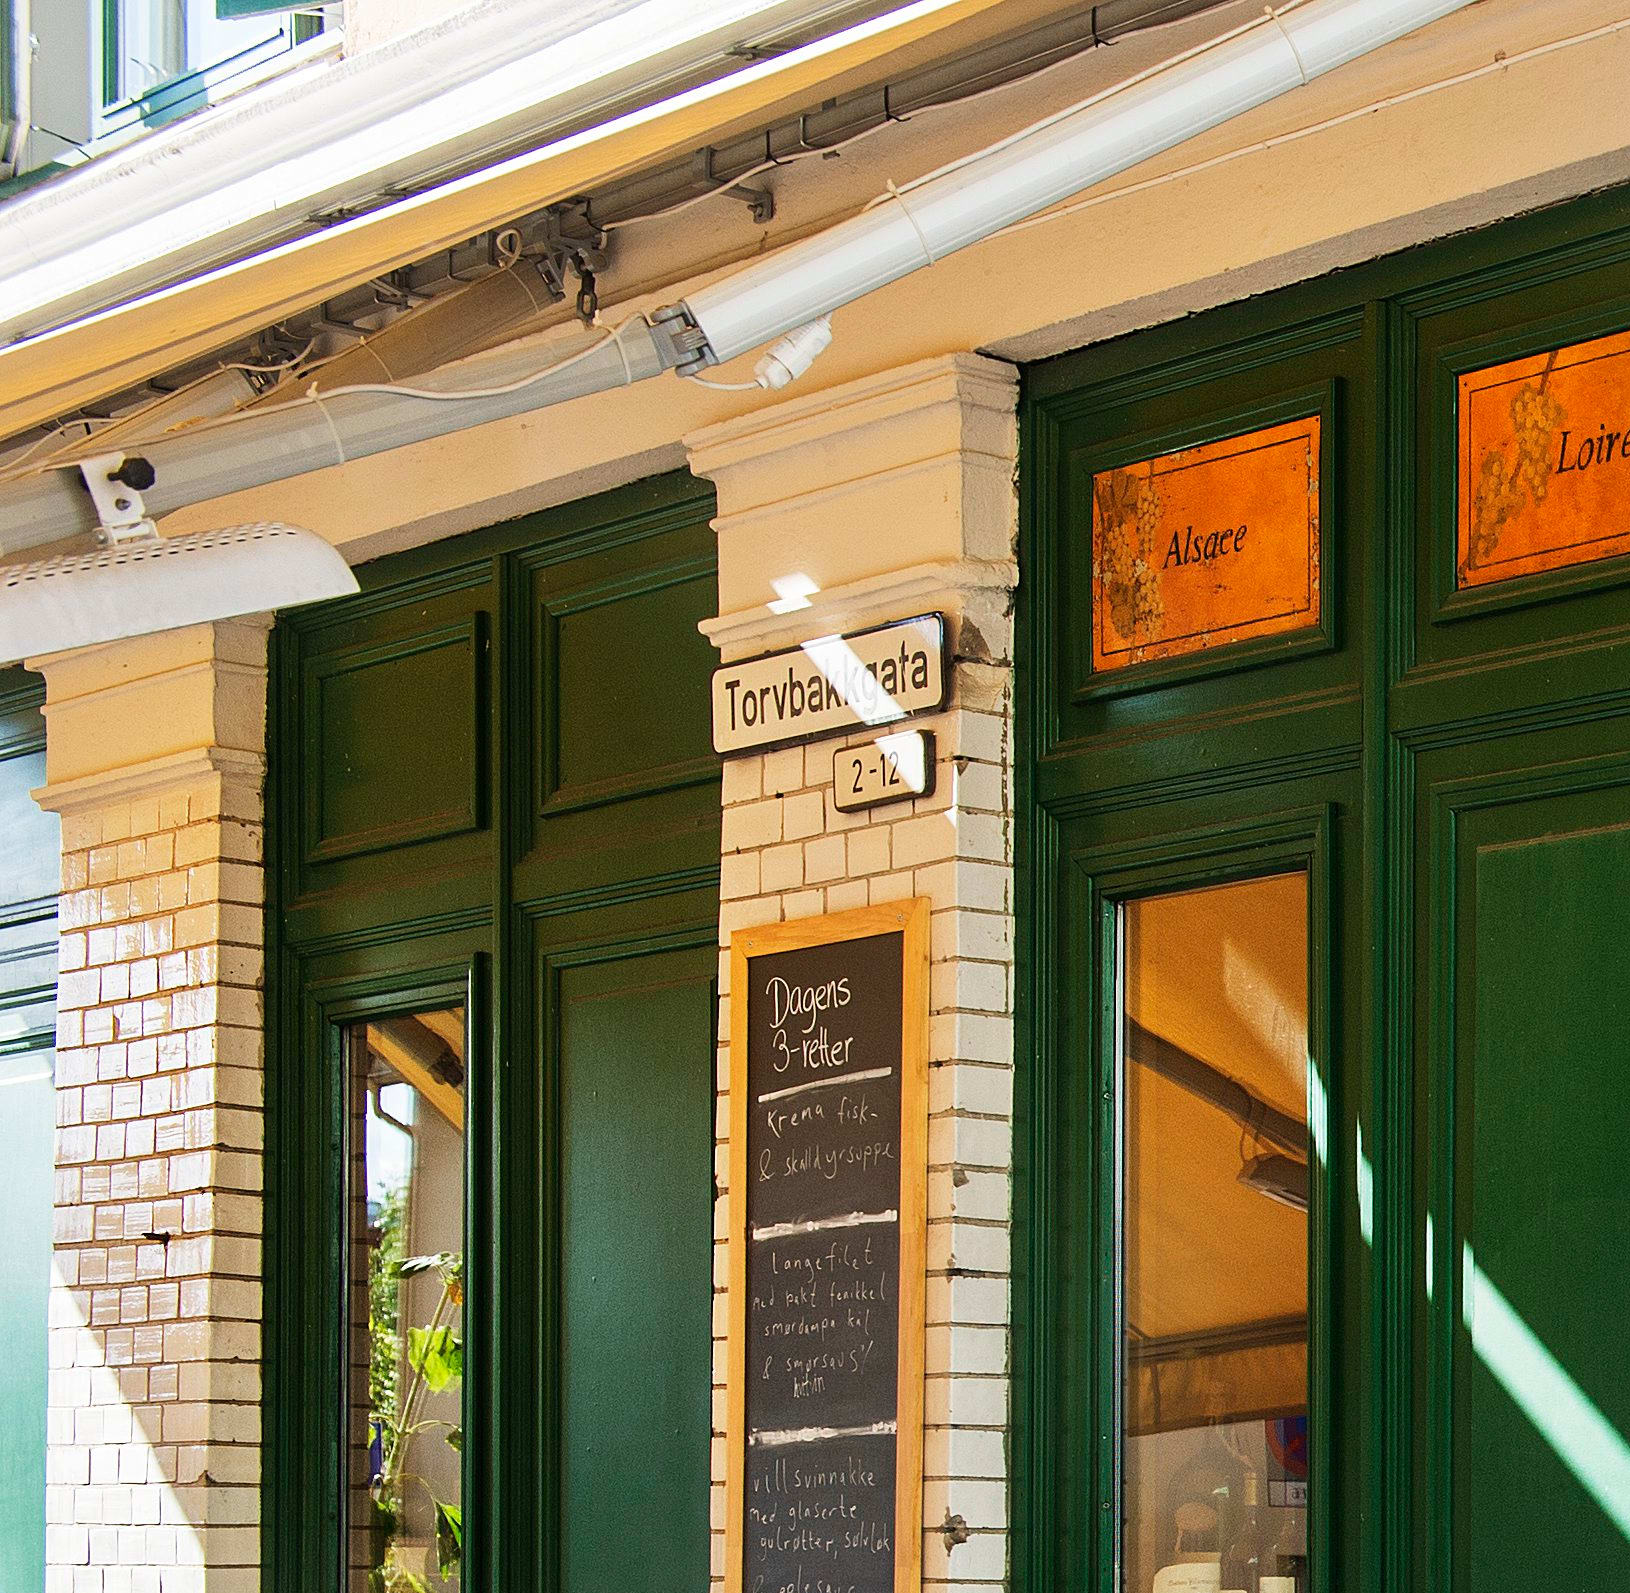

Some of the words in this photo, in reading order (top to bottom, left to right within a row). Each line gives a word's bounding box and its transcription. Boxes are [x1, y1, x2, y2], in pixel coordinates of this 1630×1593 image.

[1162, 521, 1248, 570] Alsace
[724, 640, 929, 732] Torvbakkgata
[851, 750, 901, 794] 2-12
[765, 976, 851, 1034] Dagens
[772, 1026, 854, 1072] 3-retter
